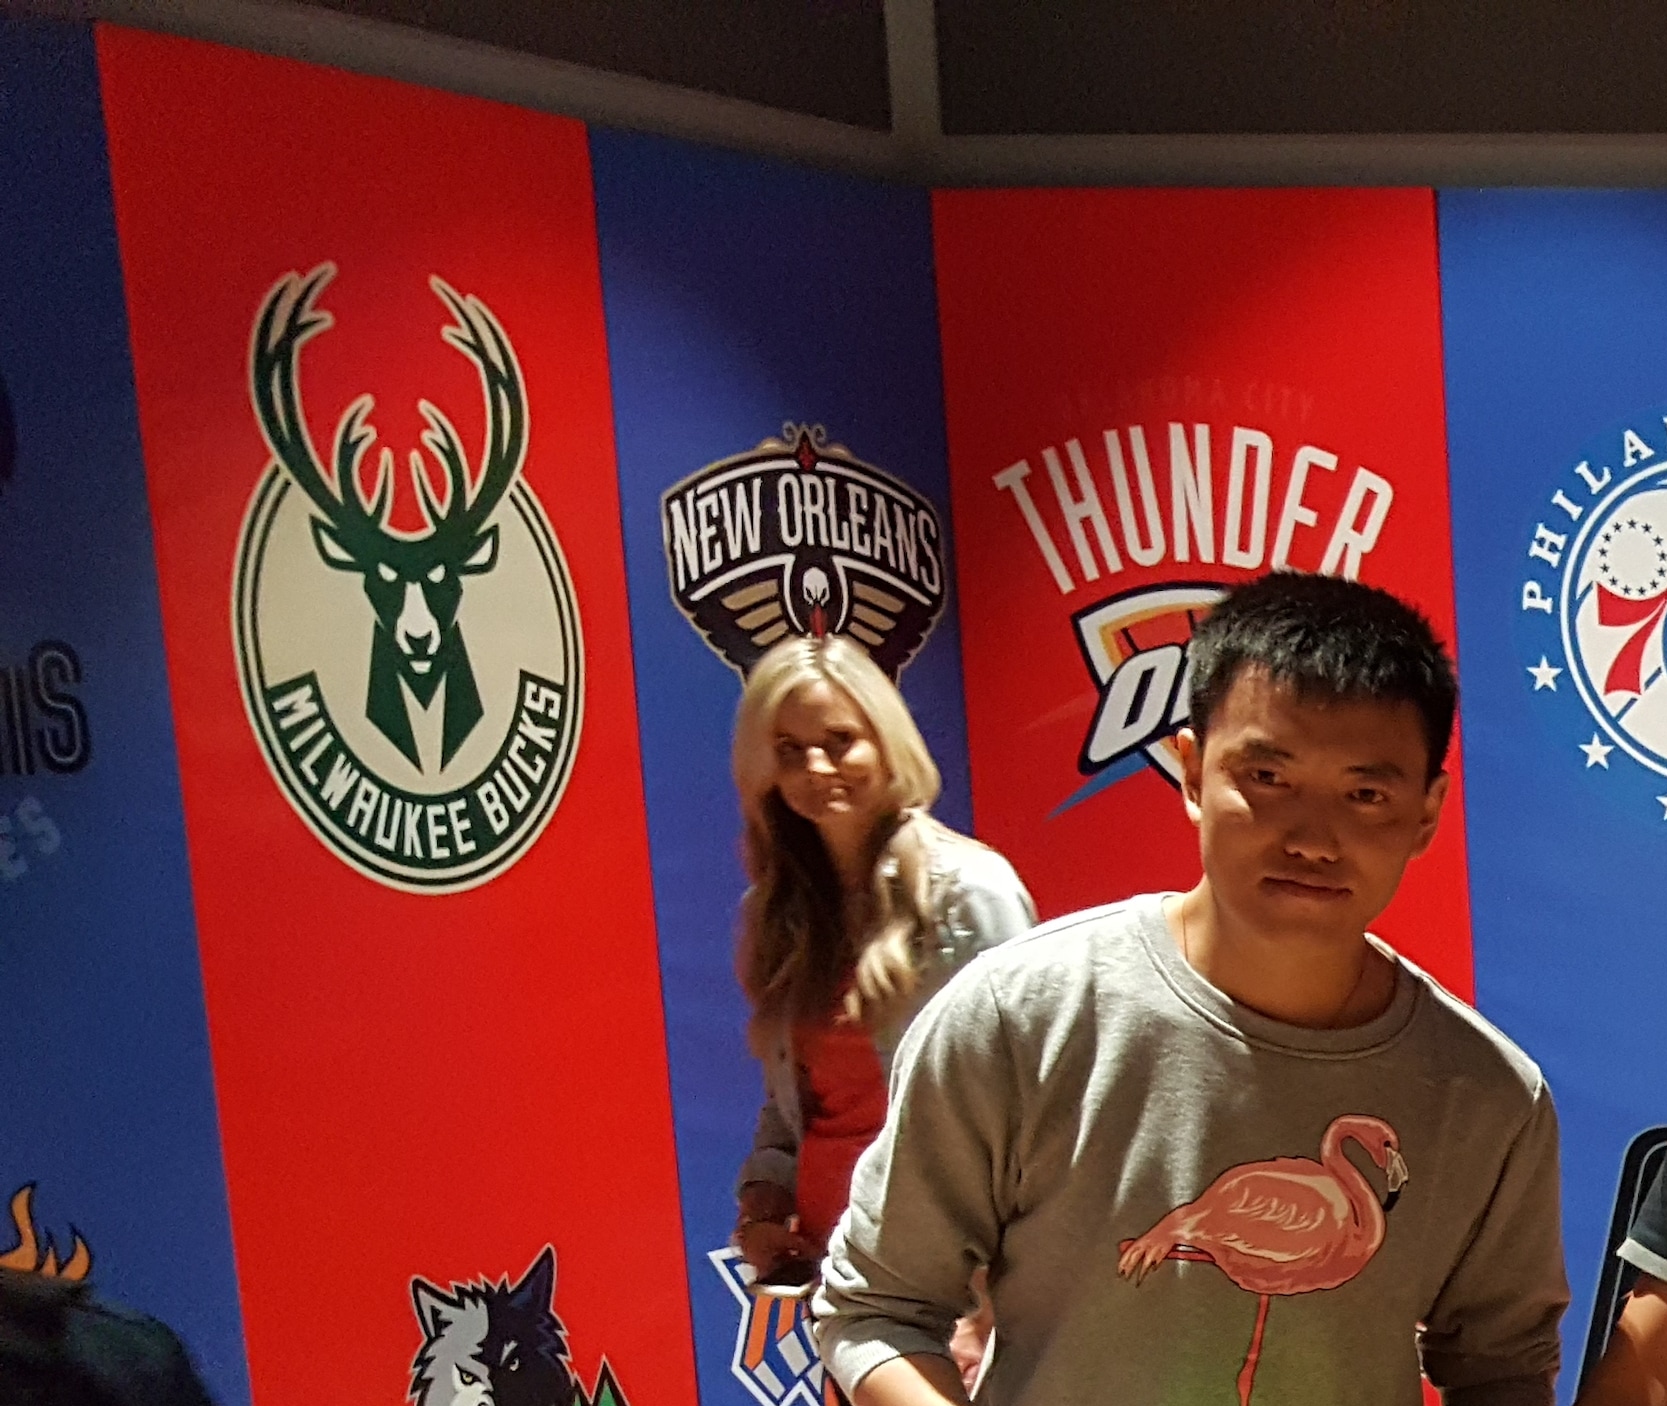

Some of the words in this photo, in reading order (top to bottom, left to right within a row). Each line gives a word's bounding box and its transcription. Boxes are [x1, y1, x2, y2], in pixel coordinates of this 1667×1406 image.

[670, 477, 763, 593] NEW
[778, 472, 941, 596] ORLEANS
[993, 422, 1394, 596] THUNDER
[271, 683, 477, 861] MILWAUKEE
[475, 680, 563, 836] BUCKS
